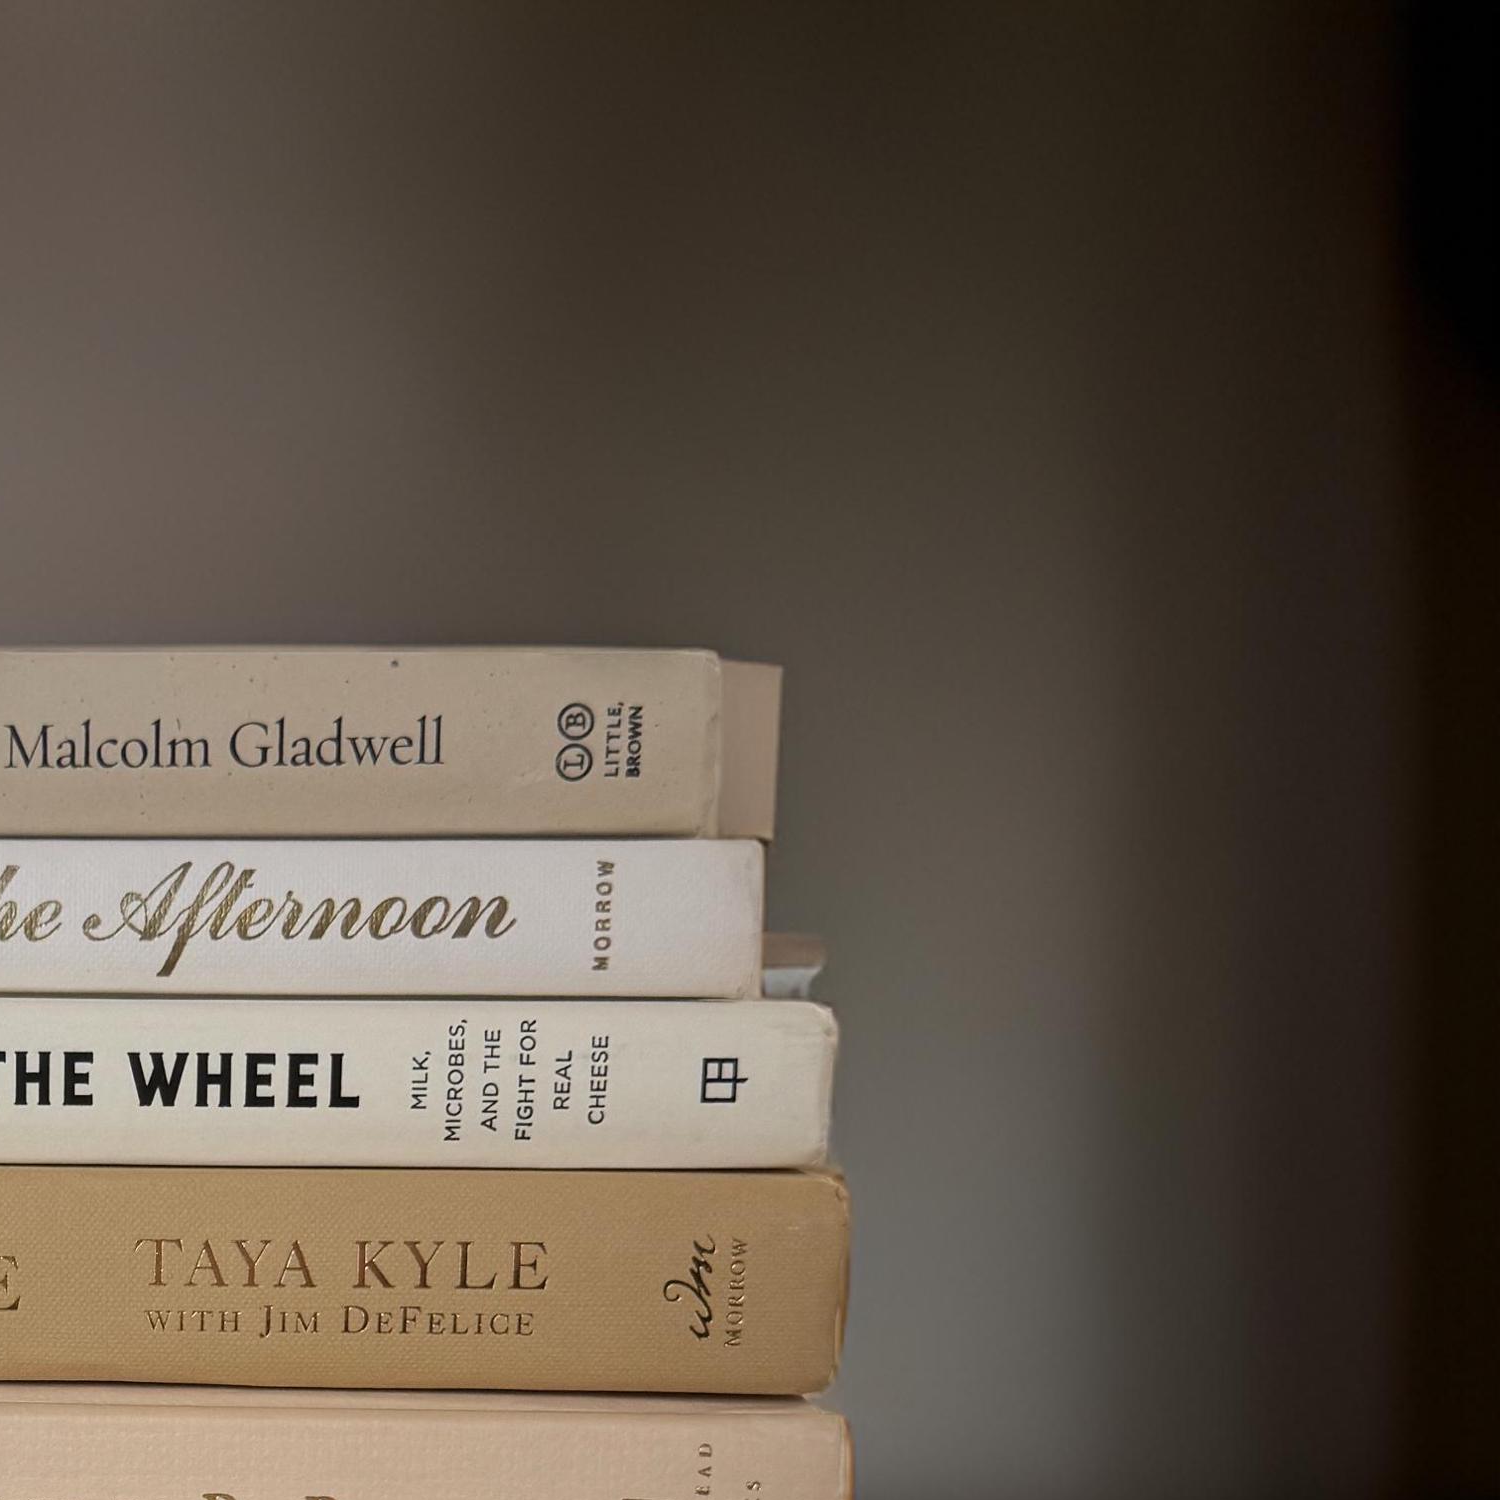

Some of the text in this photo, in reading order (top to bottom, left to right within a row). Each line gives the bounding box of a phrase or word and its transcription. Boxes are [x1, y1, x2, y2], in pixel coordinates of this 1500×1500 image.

[3, 715, 446, 771] Malcolm Gladwell
[604, 701, 625, 778] LITTLE,
[626, 705, 643, 778] BROWN
[82, 860, 517, 978] Afternoon
[592, 861, 616, 971] MORROW
[127, 1052, 361, 1109] WHEEL
[411, 1051, 432, 1110] MILK,
[444, 1019, 468, 1142] MICROBES,
[480, 1028, 501, 1131] AND THE
[514, 1019, 537, 1142] FIGHT FOR
[553, 1050, 573, 1111] REAL
[587, 1035, 610, 1125] CHEESE
[134, 1238, 550, 1293] TAYA KYLE
[723, 1238, 750, 1348] MORROW
[144, 1310, 241, 1335] WITH
